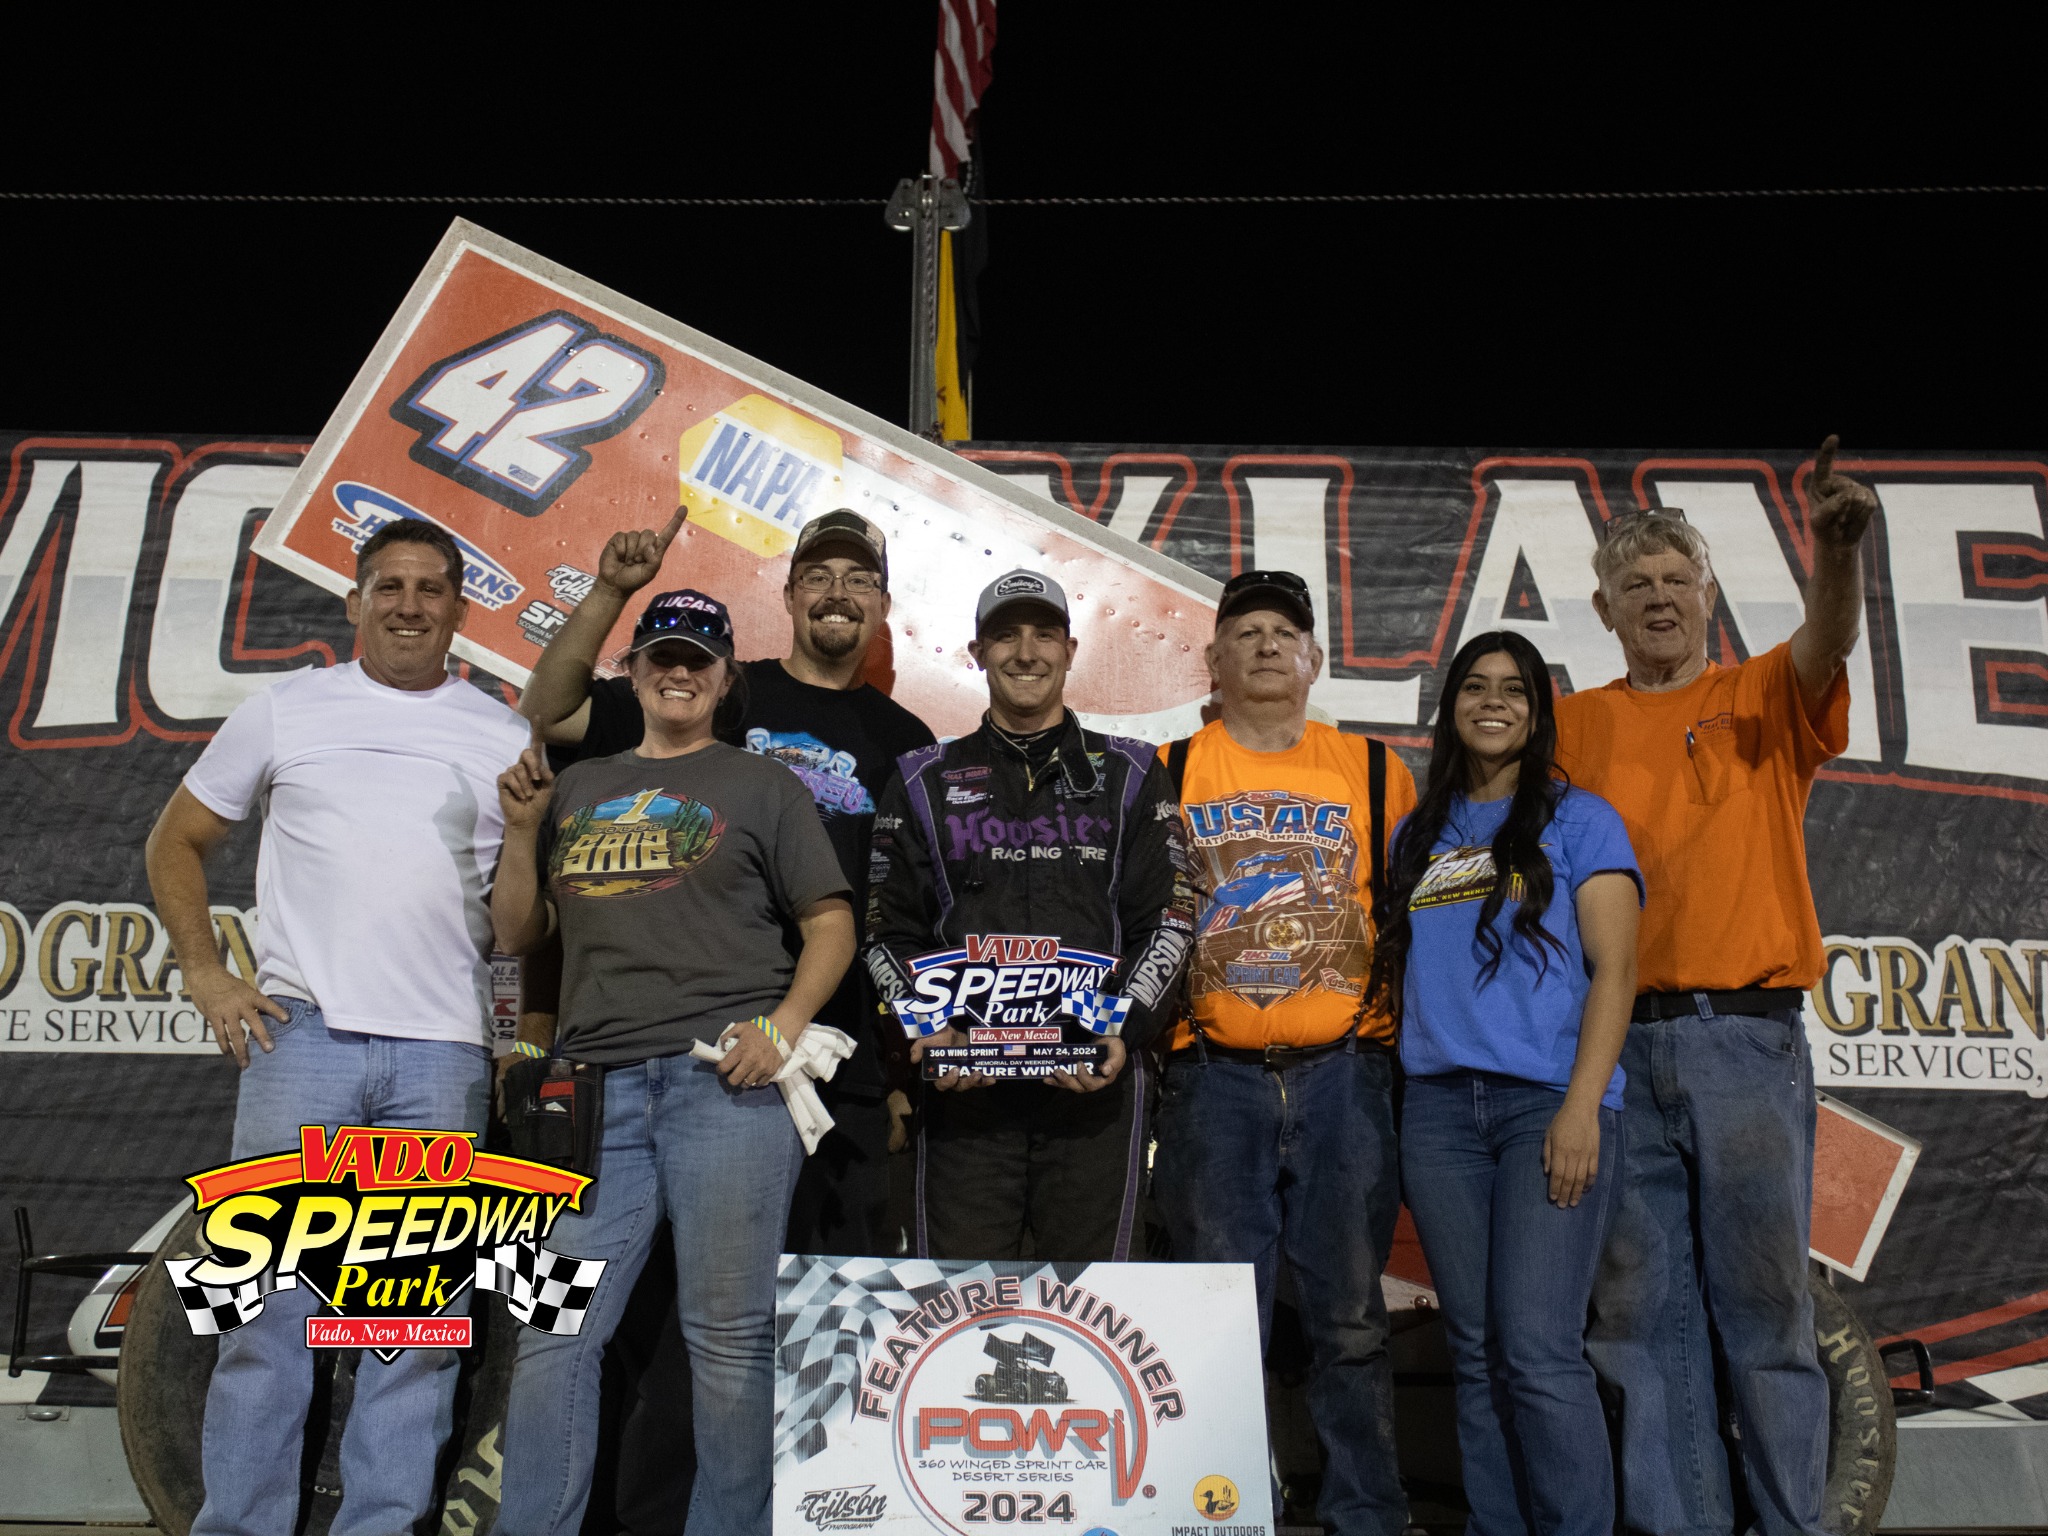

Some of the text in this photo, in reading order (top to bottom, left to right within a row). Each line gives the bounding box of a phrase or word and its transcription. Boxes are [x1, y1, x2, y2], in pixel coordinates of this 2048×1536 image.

[410, 317, 654, 498] 42
[695, 423, 826, 529] NAPA
[613, 787, 664, 824] 1
[945, 803, 1112, 860] Hoosier
[1185, 802, 1350, 842] USAC
[1195, 830, 1339, 849] NATIONAL CHAMPIONSHIP
[991, 847, 1062, 861] RACING
[966, 934, 1060, 965] VADO
[1236, 950, 1292, 962] AMSOIL
[1226, 964, 1300, 988] SPRINT CAR
[1328, 978, 1362, 992] USAC
[905, 966, 1111, 1014] SPEEDWAY
[1811, 943, 2048, 1040] GRAN
[983, 1001, 1050, 1025] Park
[971, 1030, 1058, 1043] Vado, New Mexico
[947, 1049, 968, 1057] WING
[970, 1048, 999, 1057] SPRINT
[1033, 1047, 1097, 1056] MAY 24, 2024
[1829, 1042, 2044, 1088] SERVICES,
[857, 1275, 1186, 1428] FEATURE WINNER
[918, 1459, 1108, 1470] 360 WINGED SPRINT CAR
[952, 1472, 1074, 1482] DESERT SERIES
[802, 1488, 887, 1530] Gilson
[963, 1491, 1076, 1524] 2024
[828, 1522, 875, 1531] PHOTOGRAPHY
[1172, 1526, 1266, 1536] IMPACT OUTDOORS
